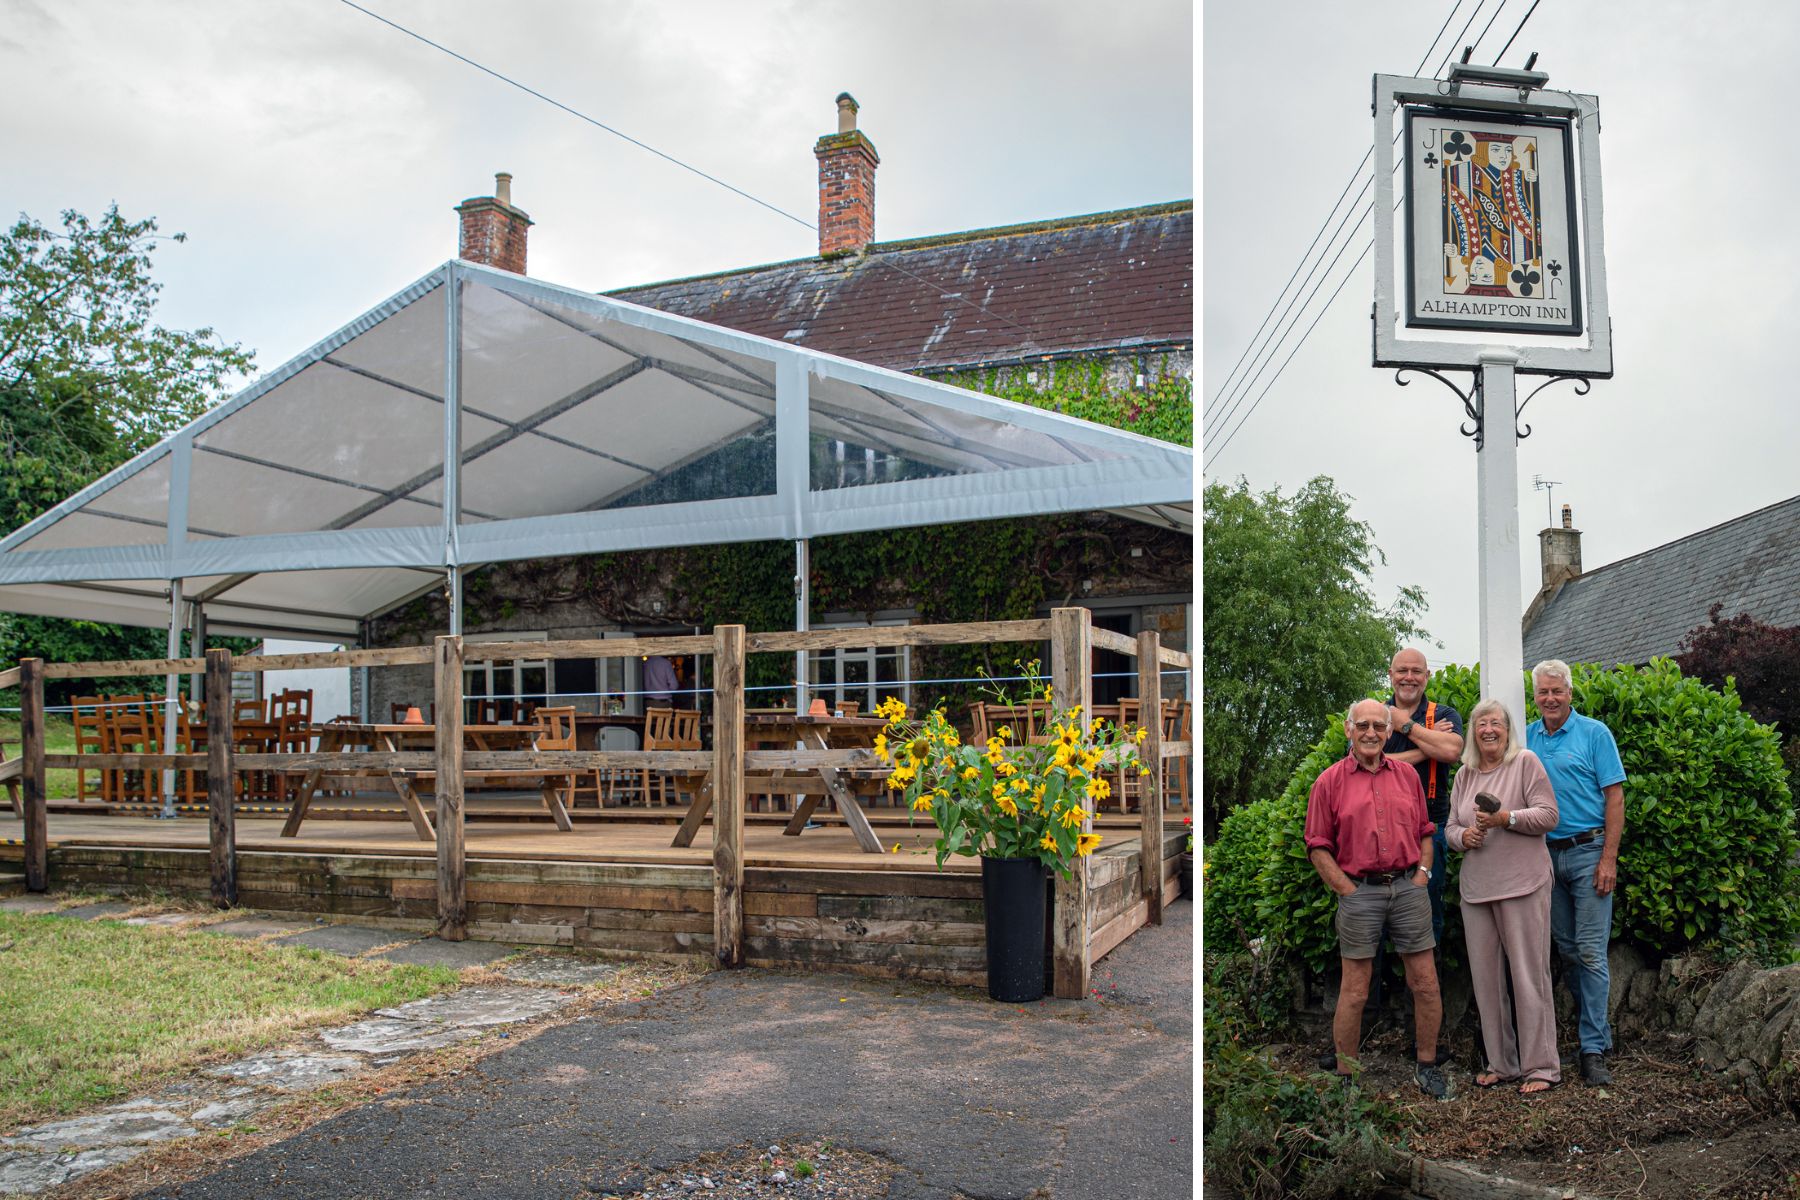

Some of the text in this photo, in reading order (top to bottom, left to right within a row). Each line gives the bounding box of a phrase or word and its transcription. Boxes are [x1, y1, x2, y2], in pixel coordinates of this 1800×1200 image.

[1422, 127, 1438, 149] J
[1421, 300, 1568, 319] ALHAMPTON INN
